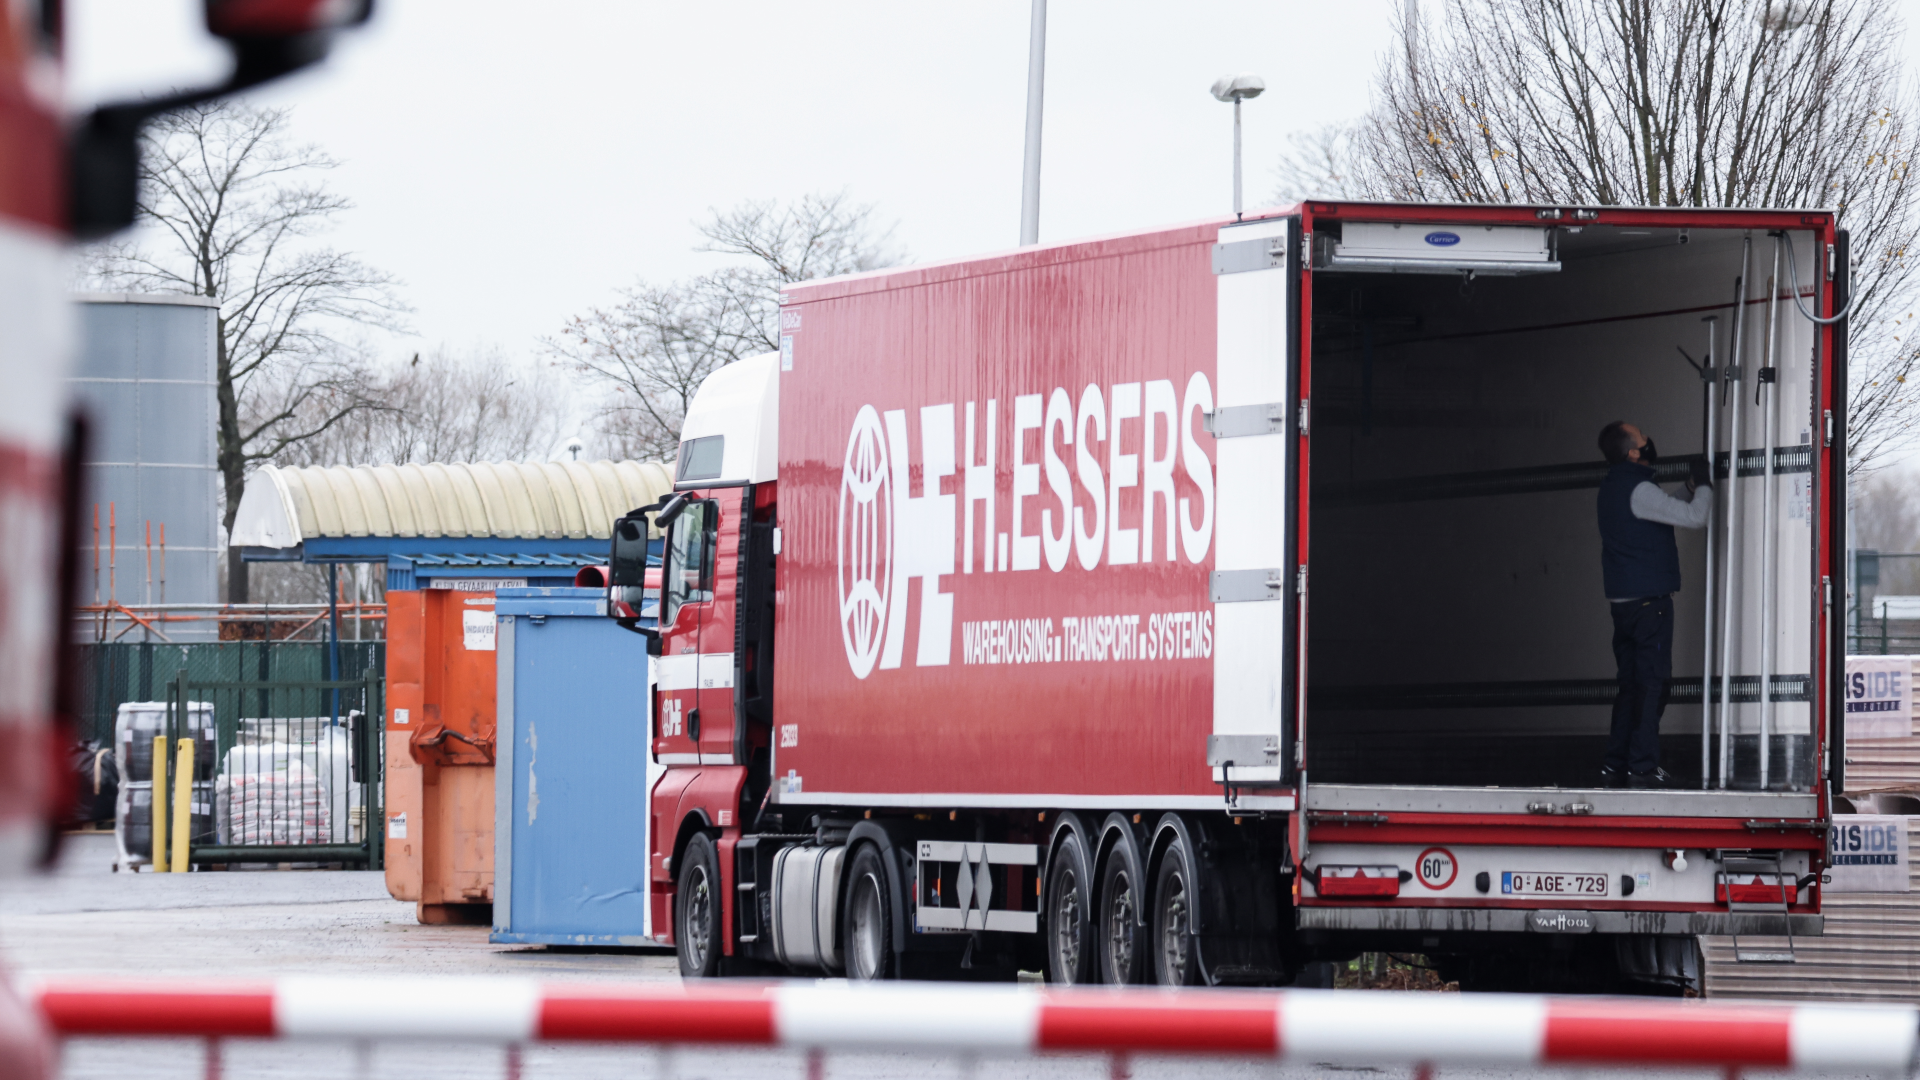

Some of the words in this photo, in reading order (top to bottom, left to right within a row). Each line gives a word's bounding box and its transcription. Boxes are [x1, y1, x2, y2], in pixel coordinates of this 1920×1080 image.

[1430, 235, 1456, 243] Carrier
[964, 371, 1214, 573] H.ESSERS
[465, 625, 494, 634] INDAVER
[1863, 701, 1902, 711] FUTURE
[1835, 855, 1853, 865] EEL
[1860, 855, 1898, 865] FUTURE
[1423, 858, 1441, 878] 60
